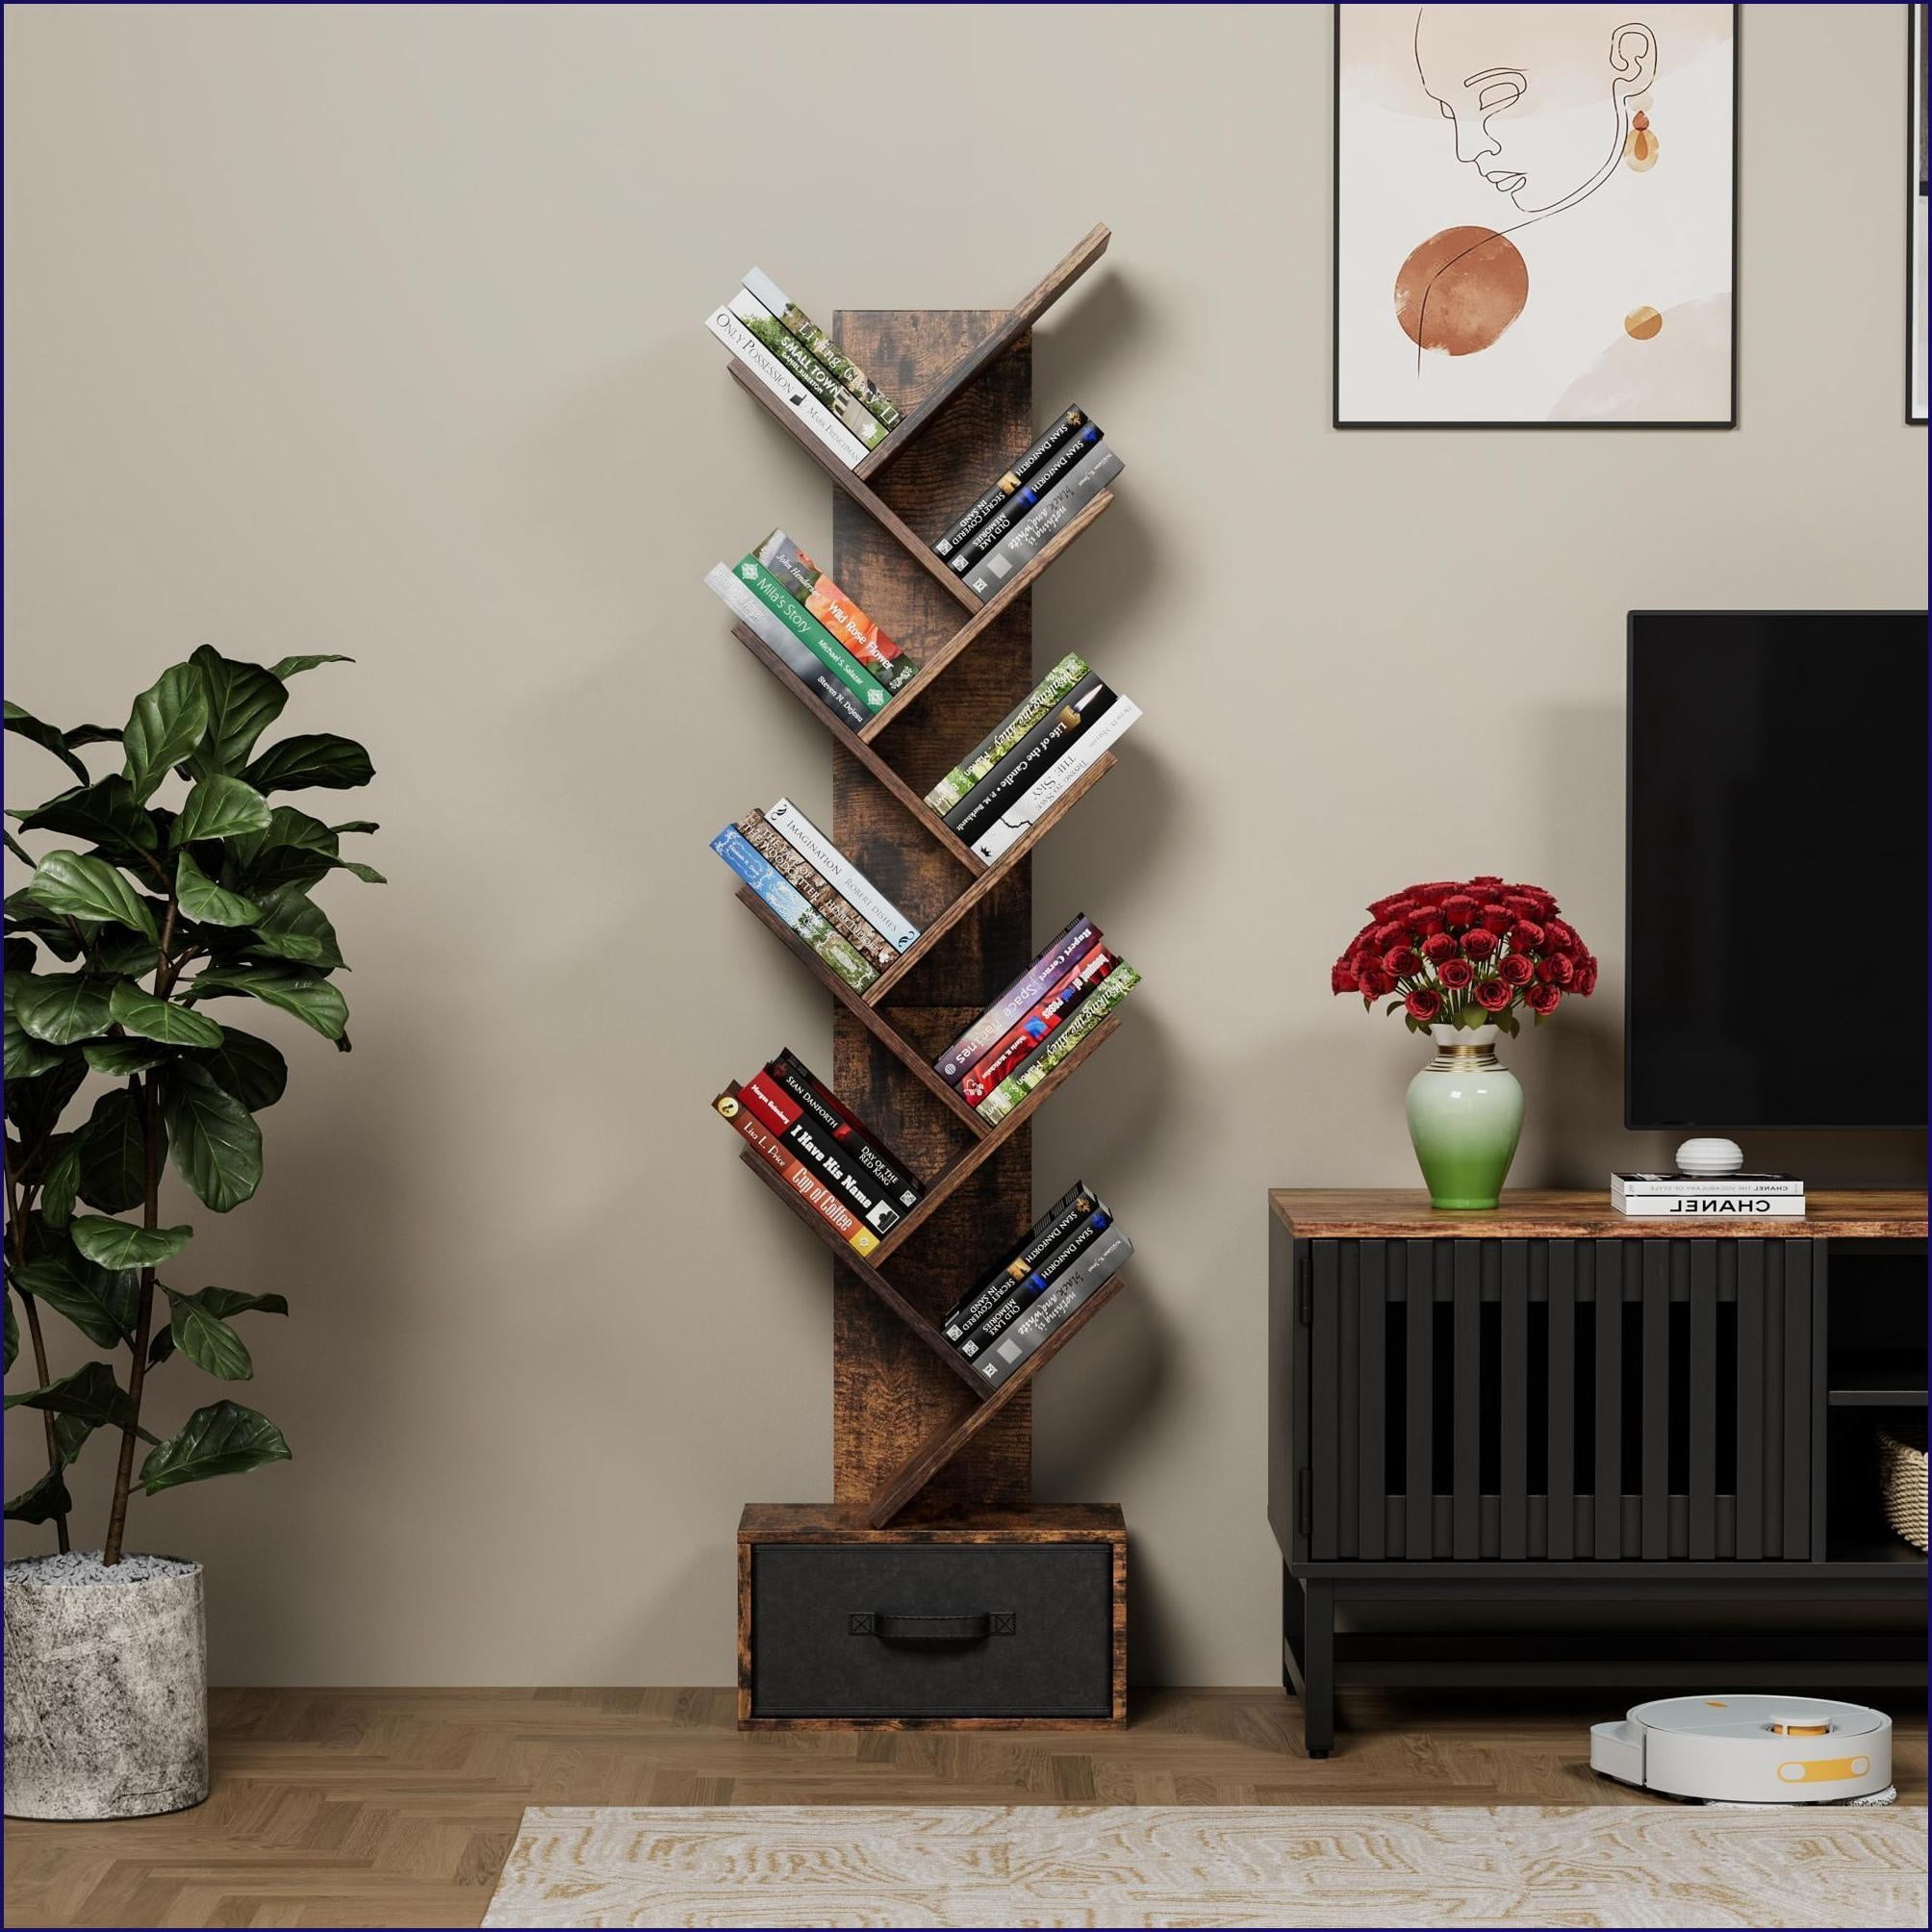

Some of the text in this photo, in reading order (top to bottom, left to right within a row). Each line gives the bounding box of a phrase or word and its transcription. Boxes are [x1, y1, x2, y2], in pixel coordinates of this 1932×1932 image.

[714, 311, 797, 394] ONLY POSSESSION
[779, 335, 842, 397] SMALL TOWN
[796, 320, 881, 406] Living Glory
[1014, 423, 1068, 476] SEAN DANFORTH
[1030, 440, 1084, 493] SEAN DANFORTH
[951, 491, 1005, 546] SECRET COVERED
[958, 499, 987, 527] IN SAND
[971, 512, 1006, 547] MEMORIES
[977, 518, 1011, 551] OLD LAKE
[1005, 485, 1075, 552] black and white
[1027, 504, 1070, 547] nothing is
[775, 551, 793, 569] John
[755, 576, 813, 636] Mila's Story
[826, 601, 896, 672] Wild Rose Flower
[816, 638, 841, 662] Michael
[842, 663, 864, 685] Salazar
[816, 674, 838, 697] Steven
[835, 693, 846, 703] N.
[1030, 670, 1072, 712] Walking
[990, 721, 1020, 750] Alley
[999, 721, 1067, 790] Life of the Candle
[1030, 753, 1077, 802] THE SKY
[743, 823, 763, 843] THE
[954, 790, 997, 832] P. M. Burkhardt
[762, 828, 780, 848] THE
[798, 865, 813, 880] OF
[785, 820, 843, 876] IMAGINATION
[1037, 927, 1092, 981] Rupert Cornet
[1077, 952, 1109, 983] bouquet
[1000, 981, 1037, 1018] Space
[1039, 996, 1064, 1020] roses
[1071, 977, 1085, 991] of
[1042, 980, 1123, 1059] Walking the Alley
[785, 1075, 839, 1129] SEAN DANFORTH
[743, 1120, 789, 1167] Lisa L. Price
[789, 1124, 876, 1208] I Have His Name
[860, 1145, 899, 1183] DAY OF THE
[858, 1154, 891, 1186] RED KING
[788, 1166, 856, 1232] Cup of Coffee
[1025, 1210, 1078, 1263] SEAN DANFORTH
[1040, 1226, 1093, 1279] SEAN DANFORTH
[960, 1277, 1015, 1332] SECRET COVERED
[968, 1284, 997, 1313] IN SAND
[980, 1297, 1016, 1333] MEMORIES
[987, 1304, 1020, 1336] OLD LAKE
[1015, 1270, 1084, 1338] black and white
[1036, 1290, 1080, 1334] nothing is
